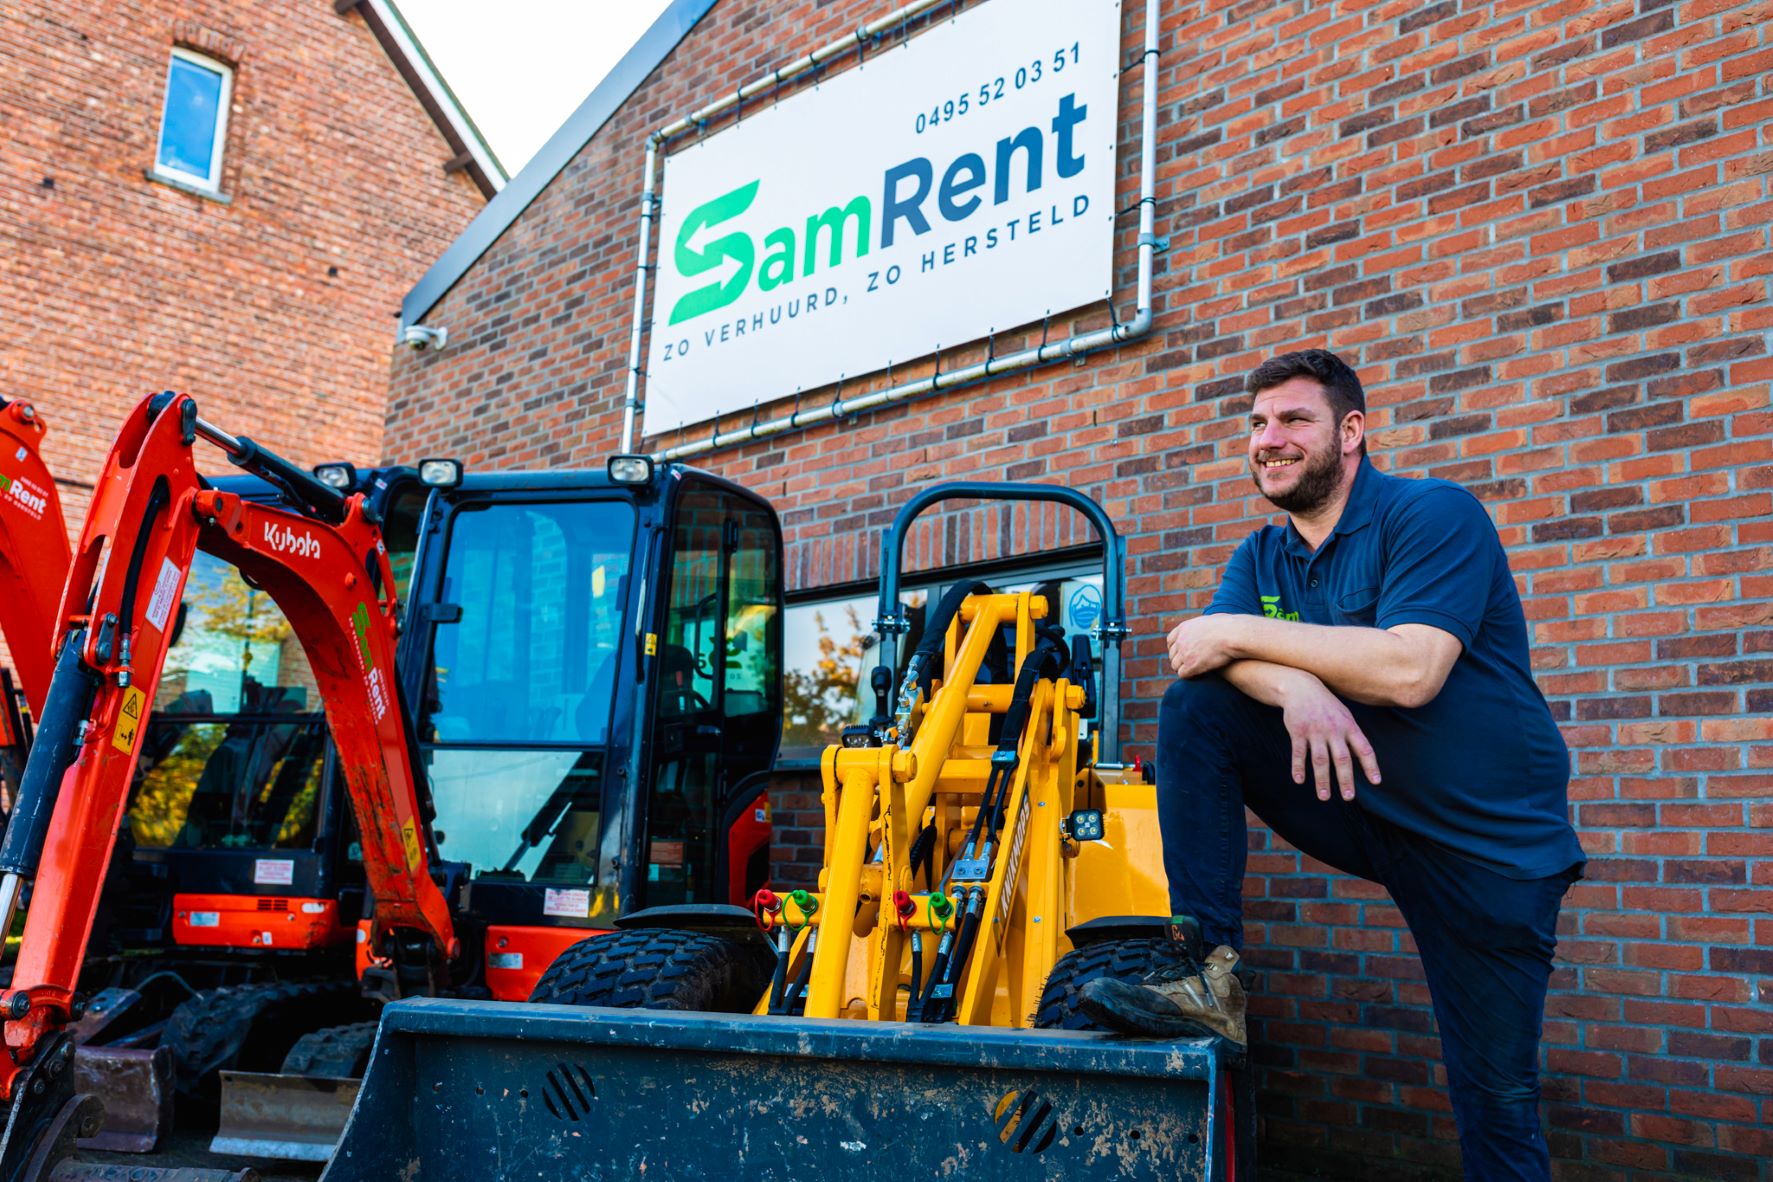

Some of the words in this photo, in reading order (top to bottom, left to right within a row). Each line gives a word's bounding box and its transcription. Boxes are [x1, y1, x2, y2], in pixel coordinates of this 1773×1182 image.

[915, 92, 970, 135] 0495
[978, 76, 1006, 107] 52
[1014, 59, 1043, 91] 03
[1052, 40, 1080, 73] 51
[667, 91, 1088, 327] SamRent
[663, 338, 689, 362] ZO
[704, 287, 848, 348] VERHUURD,
[866, 264, 902, 293] ZO
[921, 194, 1090, 273] HERSTELD
[0, 474, 47, 515] mRent
[264, 521, 321, 560] Kubota
[352, 601, 386, 720] SamRent
